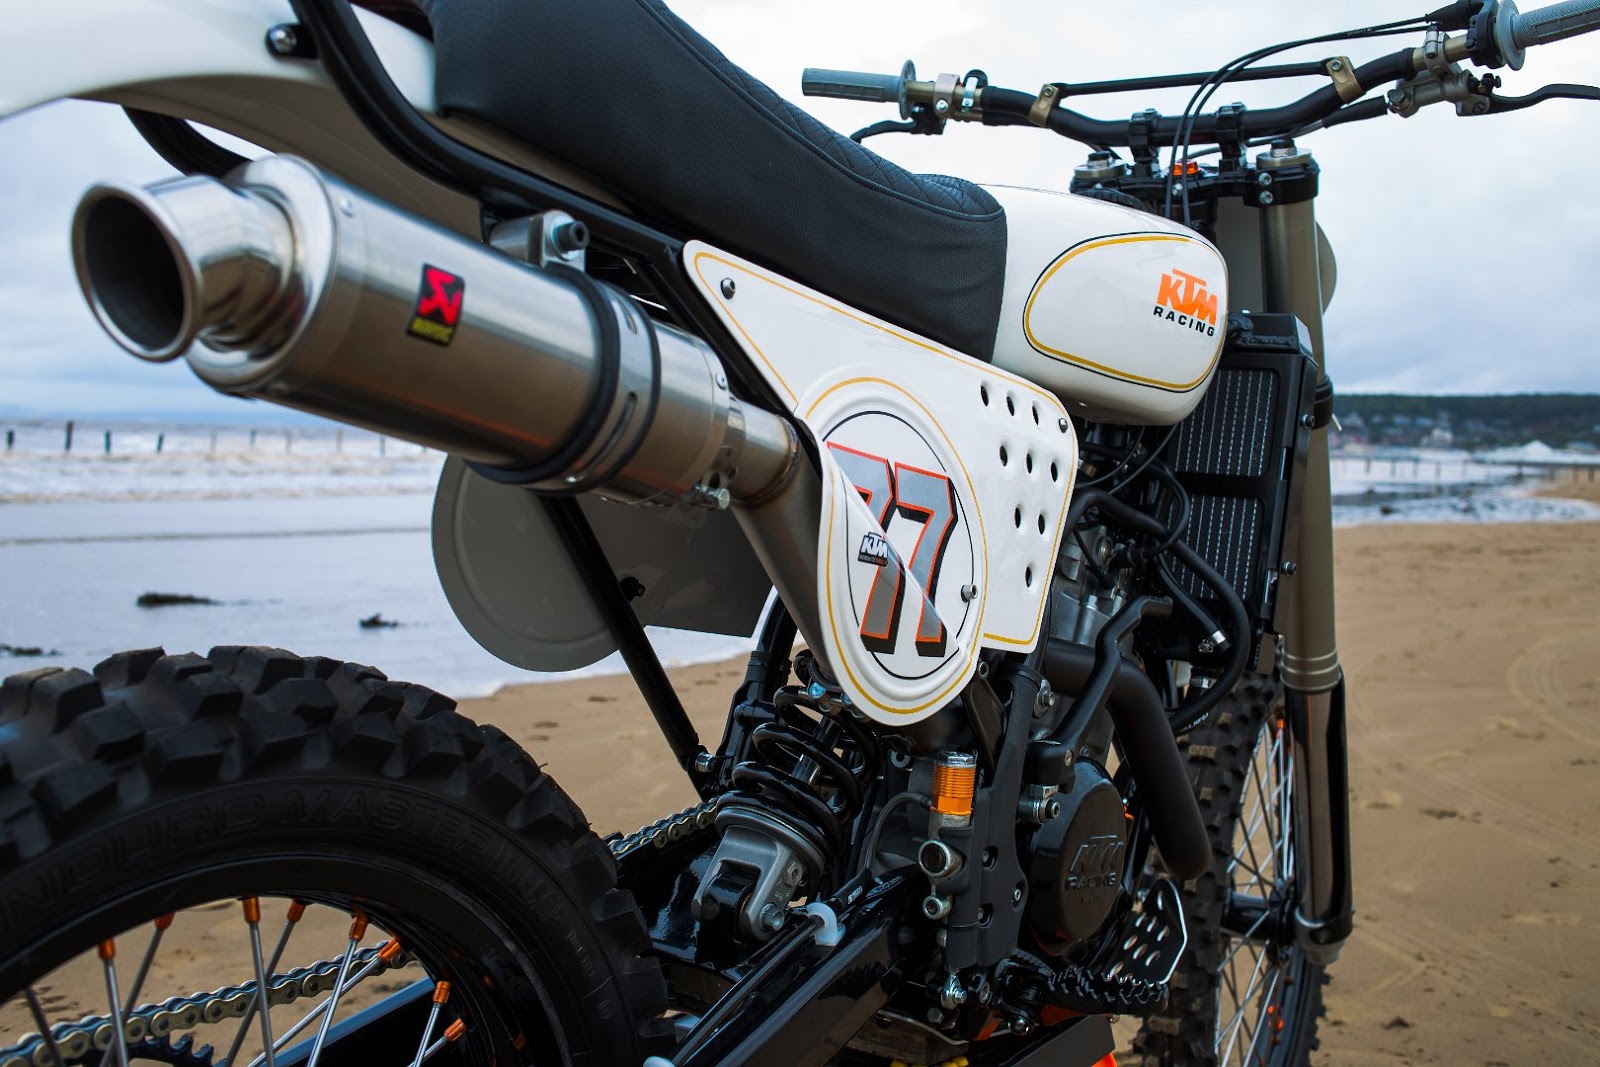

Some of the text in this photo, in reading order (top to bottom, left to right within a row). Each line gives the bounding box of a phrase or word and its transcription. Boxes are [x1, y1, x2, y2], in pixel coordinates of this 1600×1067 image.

[1156, 268, 1218, 326] KTM
[1153, 305, 1215, 337] RACING
[826, 441, 959, 658] 77
[860, 532, 889, 558] KTM
